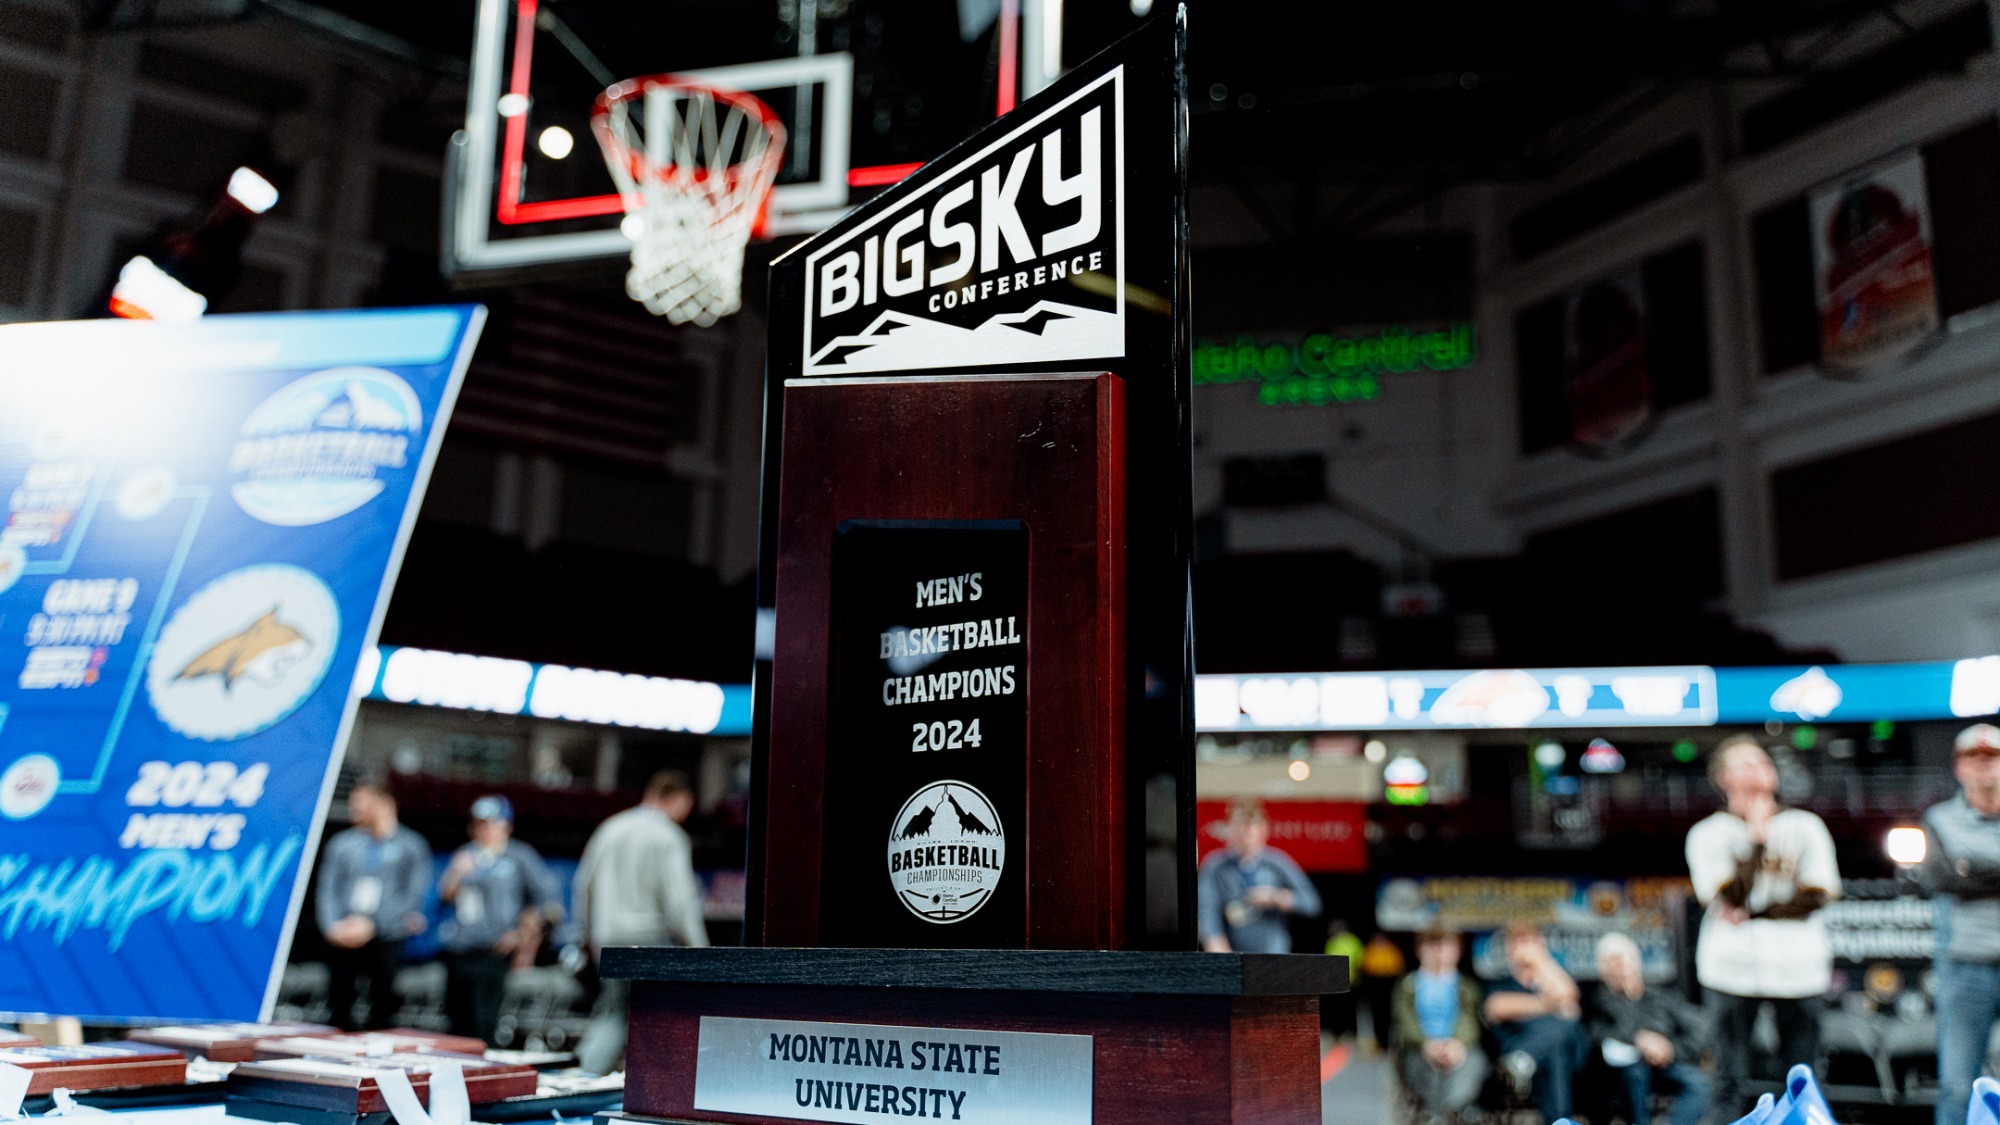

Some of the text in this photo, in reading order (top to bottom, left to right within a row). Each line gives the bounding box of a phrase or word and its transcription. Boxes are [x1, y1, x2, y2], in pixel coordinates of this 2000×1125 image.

[929, 252, 1102, 313] CONFERENCE
[916, 572, 983, 608] MEN'S
[880, 616, 1021, 659] BASKETBALL
[883, 665, 1015, 706] CHAMPIONS
[912, 718, 982, 752] 2024
[126, 761, 270, 807] 2024
[119, 813, 246, 850] MEN'S
[891, 845, 1000, 873] BASKETBALL
[907, 868, 983, 884] CHAMPIONSHIPS
[769, 1033, 1000, 1075] MONTANA STATE
[795, 1078, 966, 1120] UNIVERSITY
